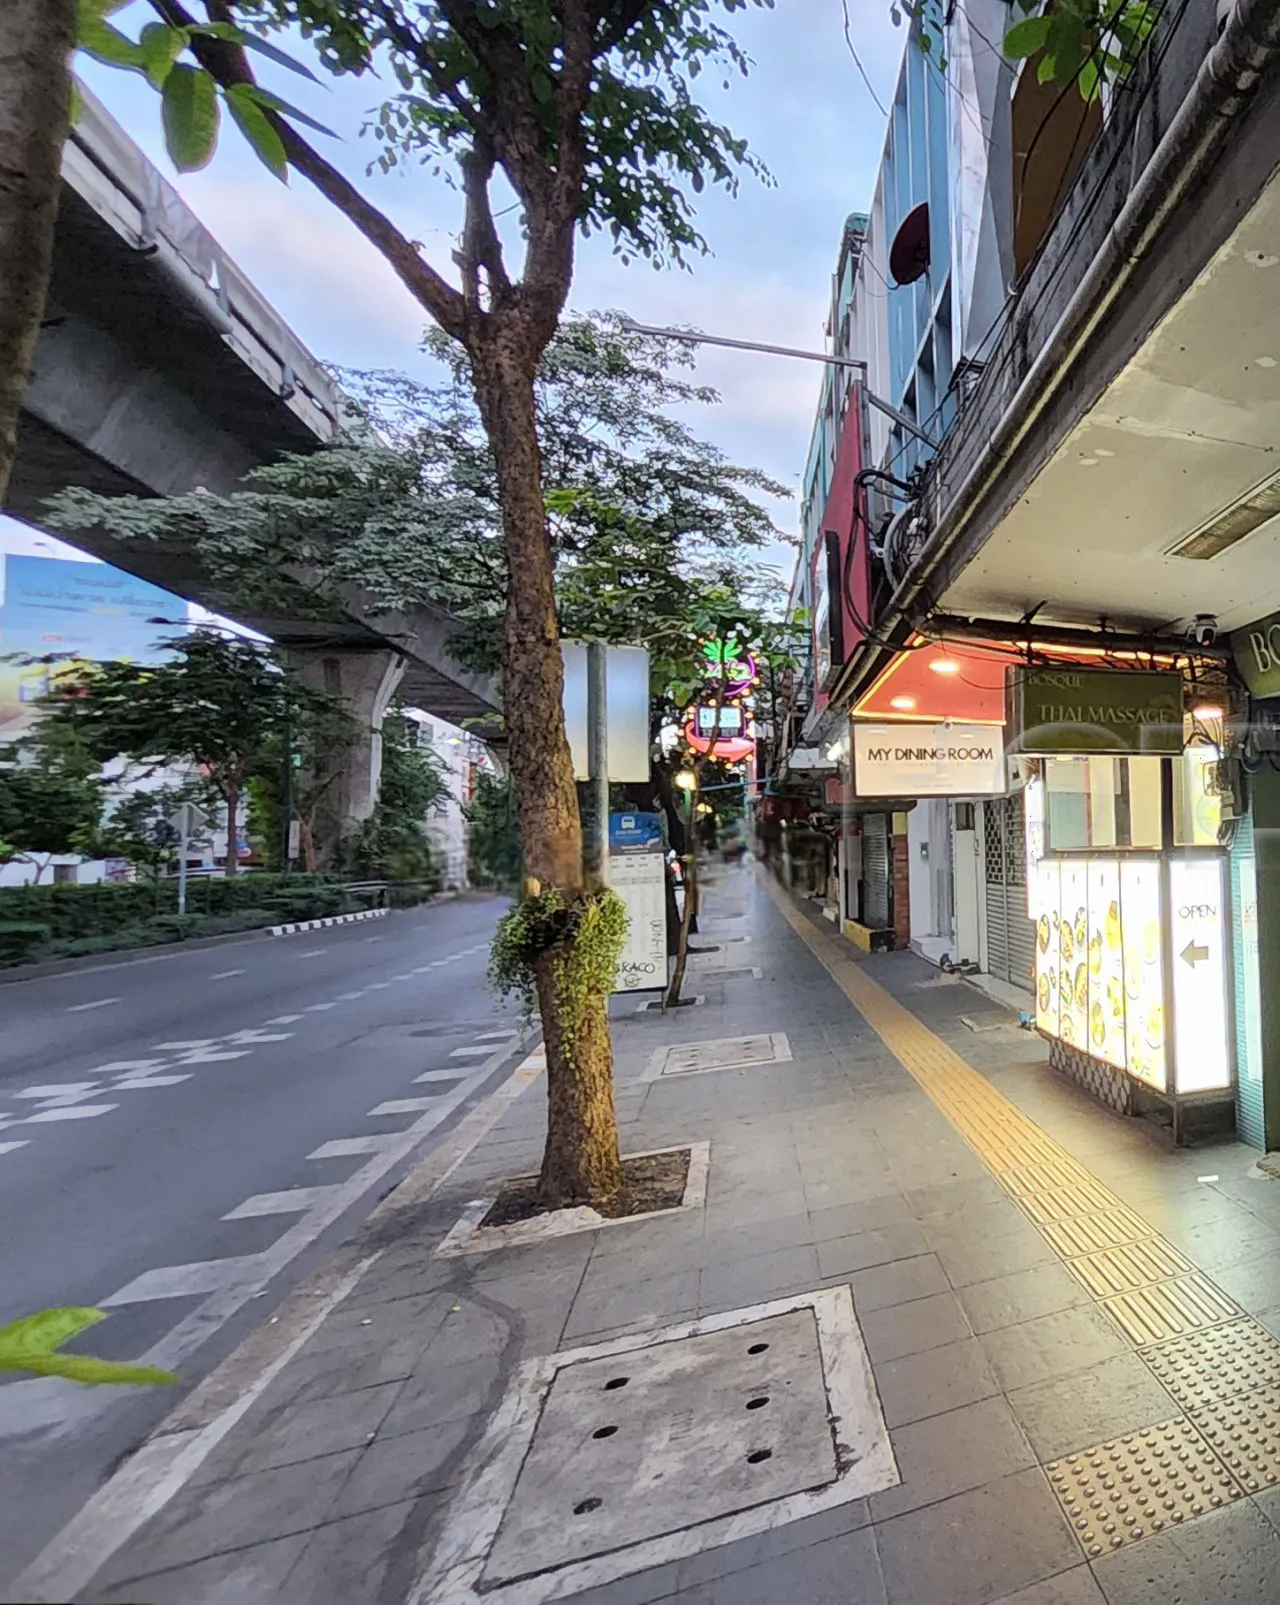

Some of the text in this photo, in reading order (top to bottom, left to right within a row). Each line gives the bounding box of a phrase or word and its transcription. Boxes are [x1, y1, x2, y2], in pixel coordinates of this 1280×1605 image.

[1036, 703, 1171, 725] THAI MASSAGE
[867, 747, 994, 761] MY DINING ROOM
[1178, 903, 1217, 919] OPEN
